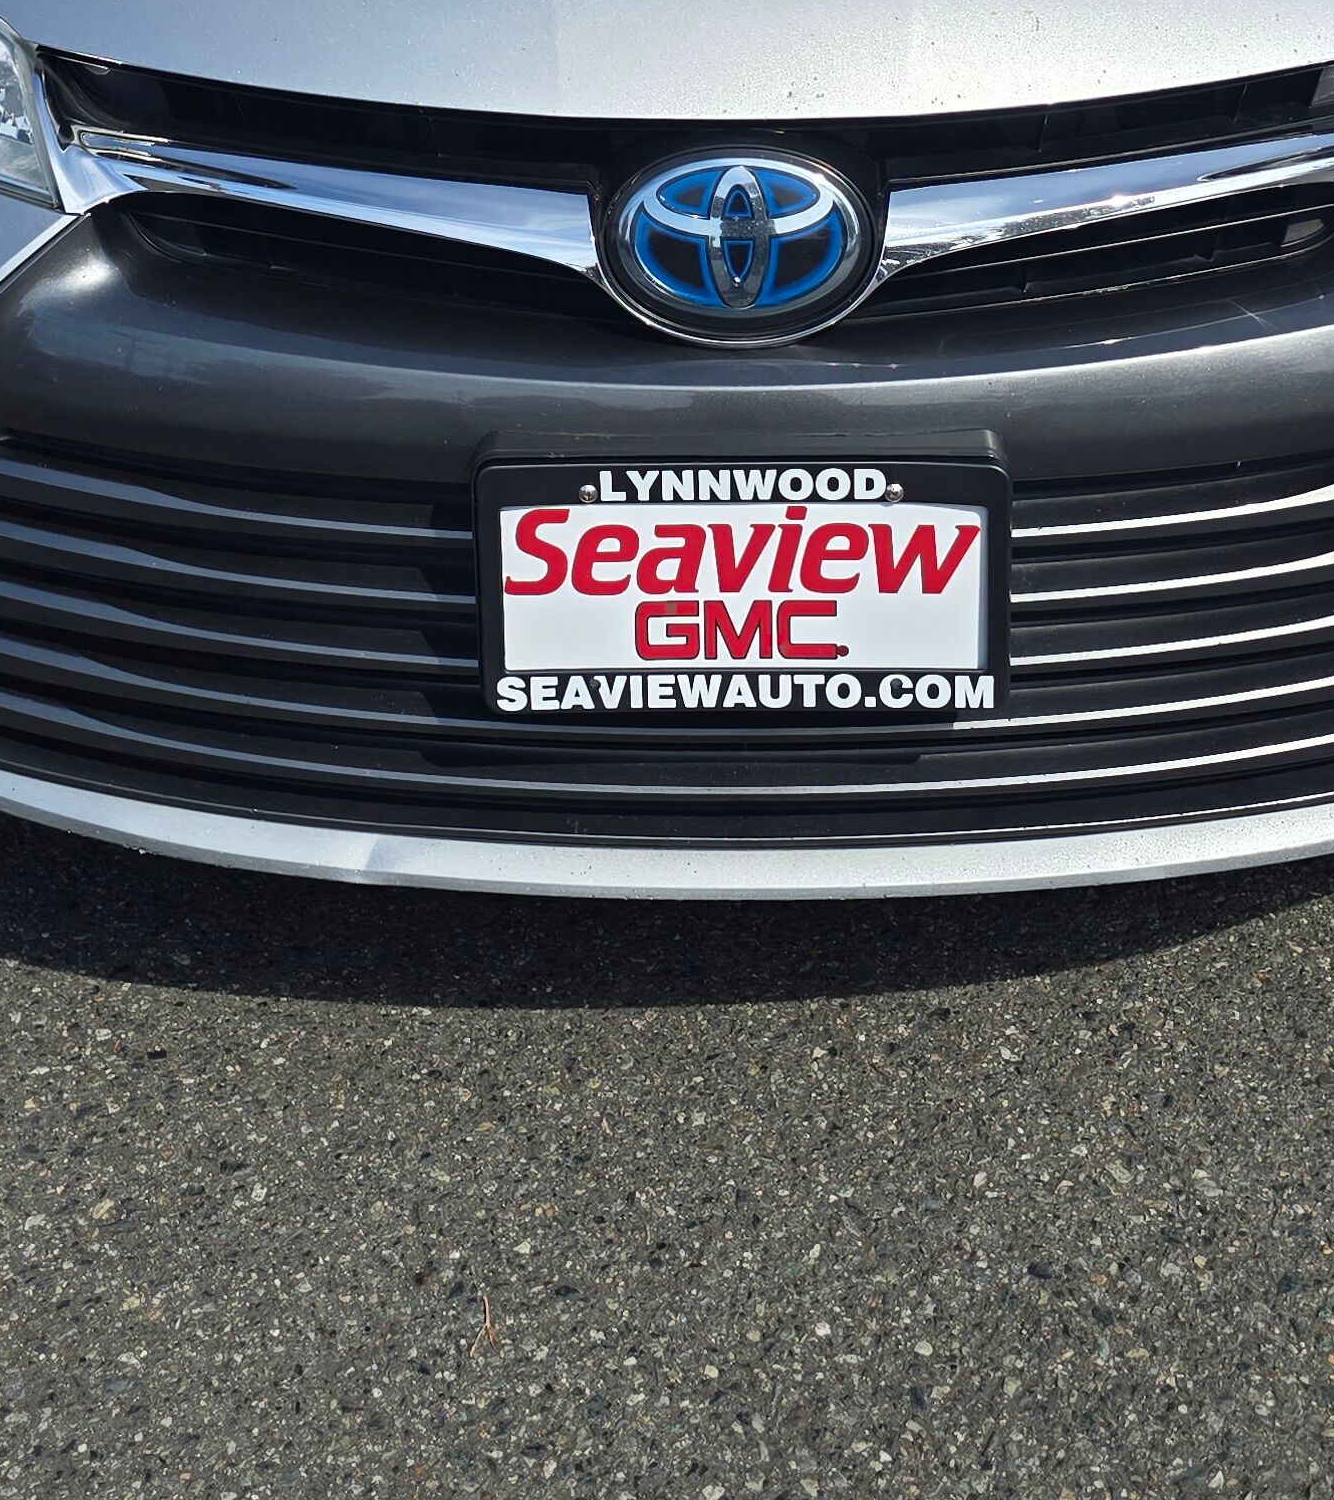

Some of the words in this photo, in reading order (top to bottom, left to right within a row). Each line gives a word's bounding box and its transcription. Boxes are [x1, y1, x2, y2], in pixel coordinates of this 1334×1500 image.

[598, 469, 886, 502] LYNNWOOD
[504, 506, 981, 595] Seaview
[634, 600, 838, 660] GMC
[496, 674, 994, 712] SEAVIEWAUTO.COM
